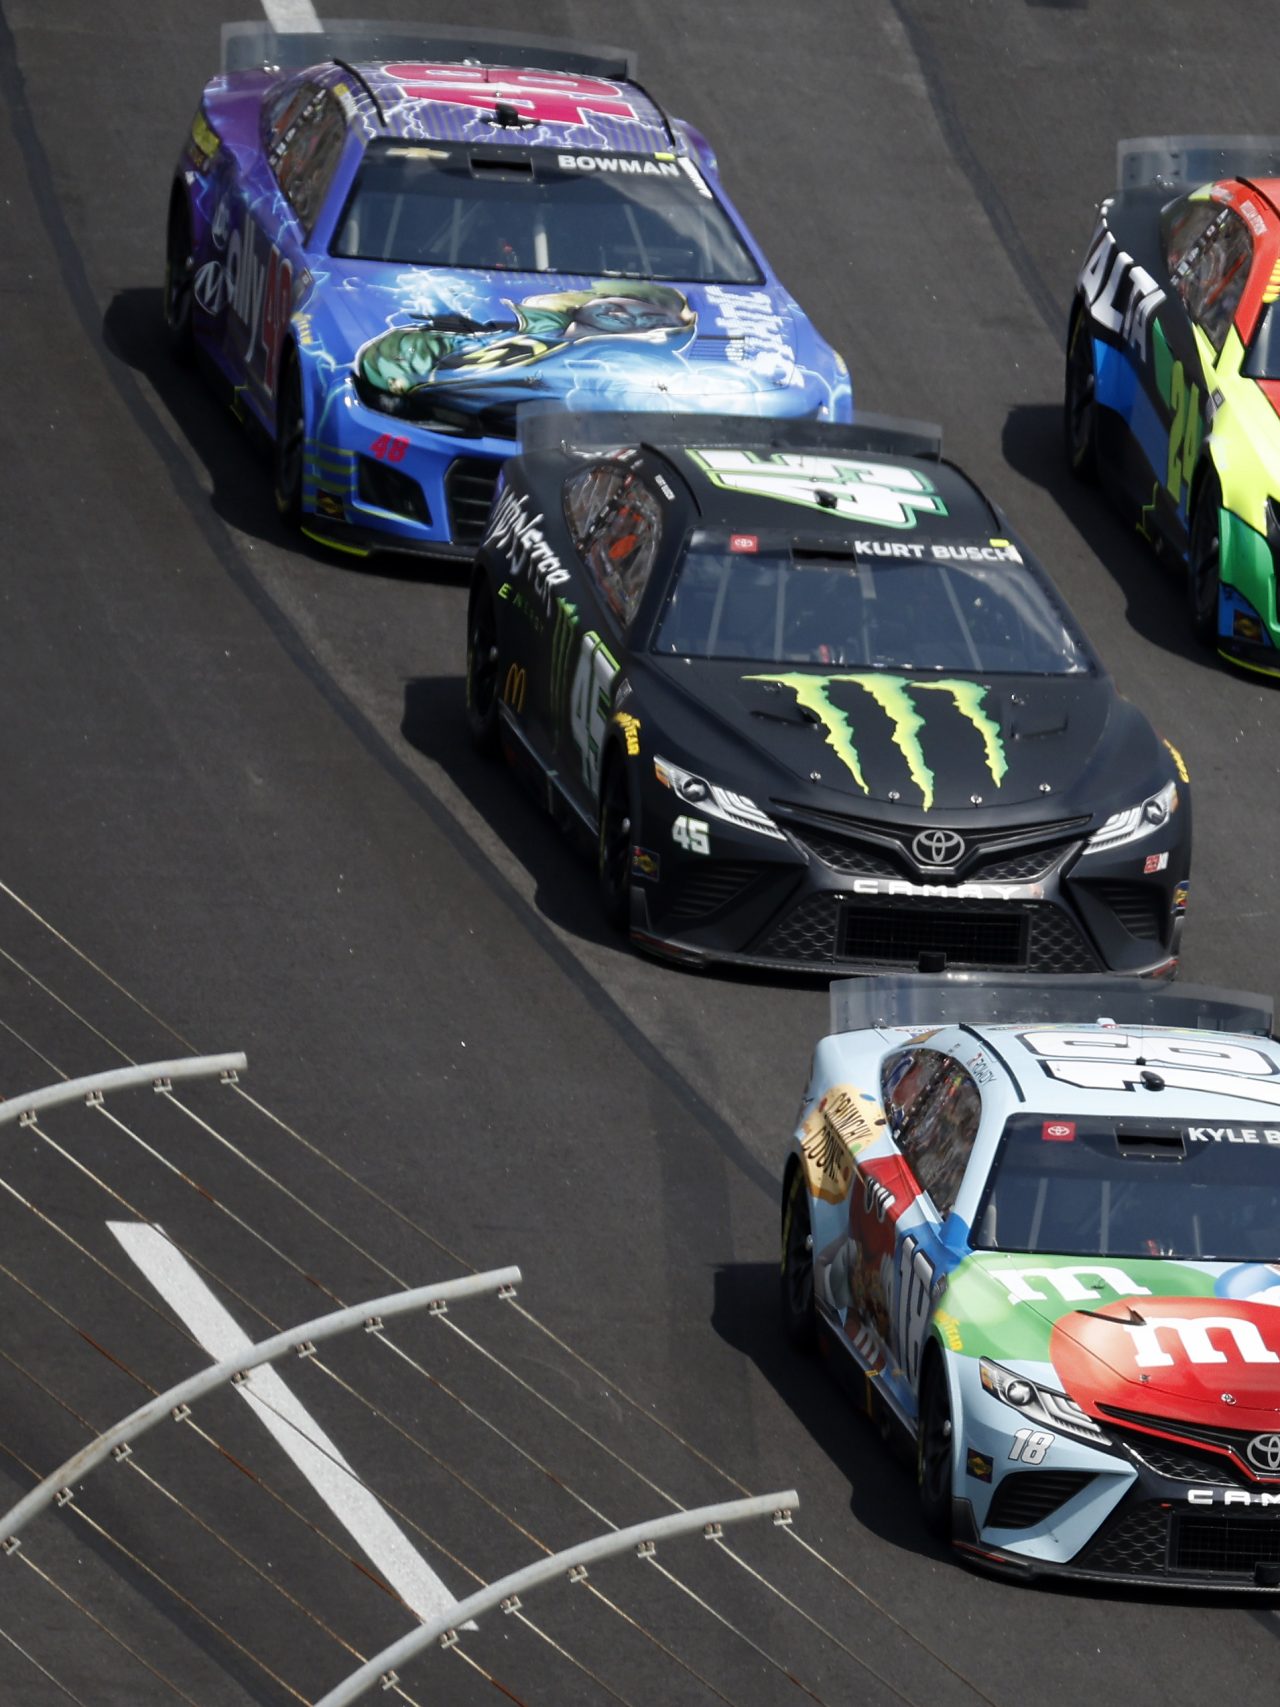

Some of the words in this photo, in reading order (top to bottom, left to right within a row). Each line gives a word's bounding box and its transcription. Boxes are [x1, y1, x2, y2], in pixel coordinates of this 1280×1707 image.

[381, 63, 639, 126] 48
[557, 154, 681, 177] BOWMAN
[368, 433, 410, 462] 48
[685, 448, 949, 529] 45
[855, 539, 924, 559] KURT
[934, 544, 1012, 561] BUSCH
[672, 815, 710, 855] 45
[1188, 1127, 1259, 1145] KYLE
[1123, 1315, 1280, 1368] m
[1008, 1428, 1055, 1466] 18
